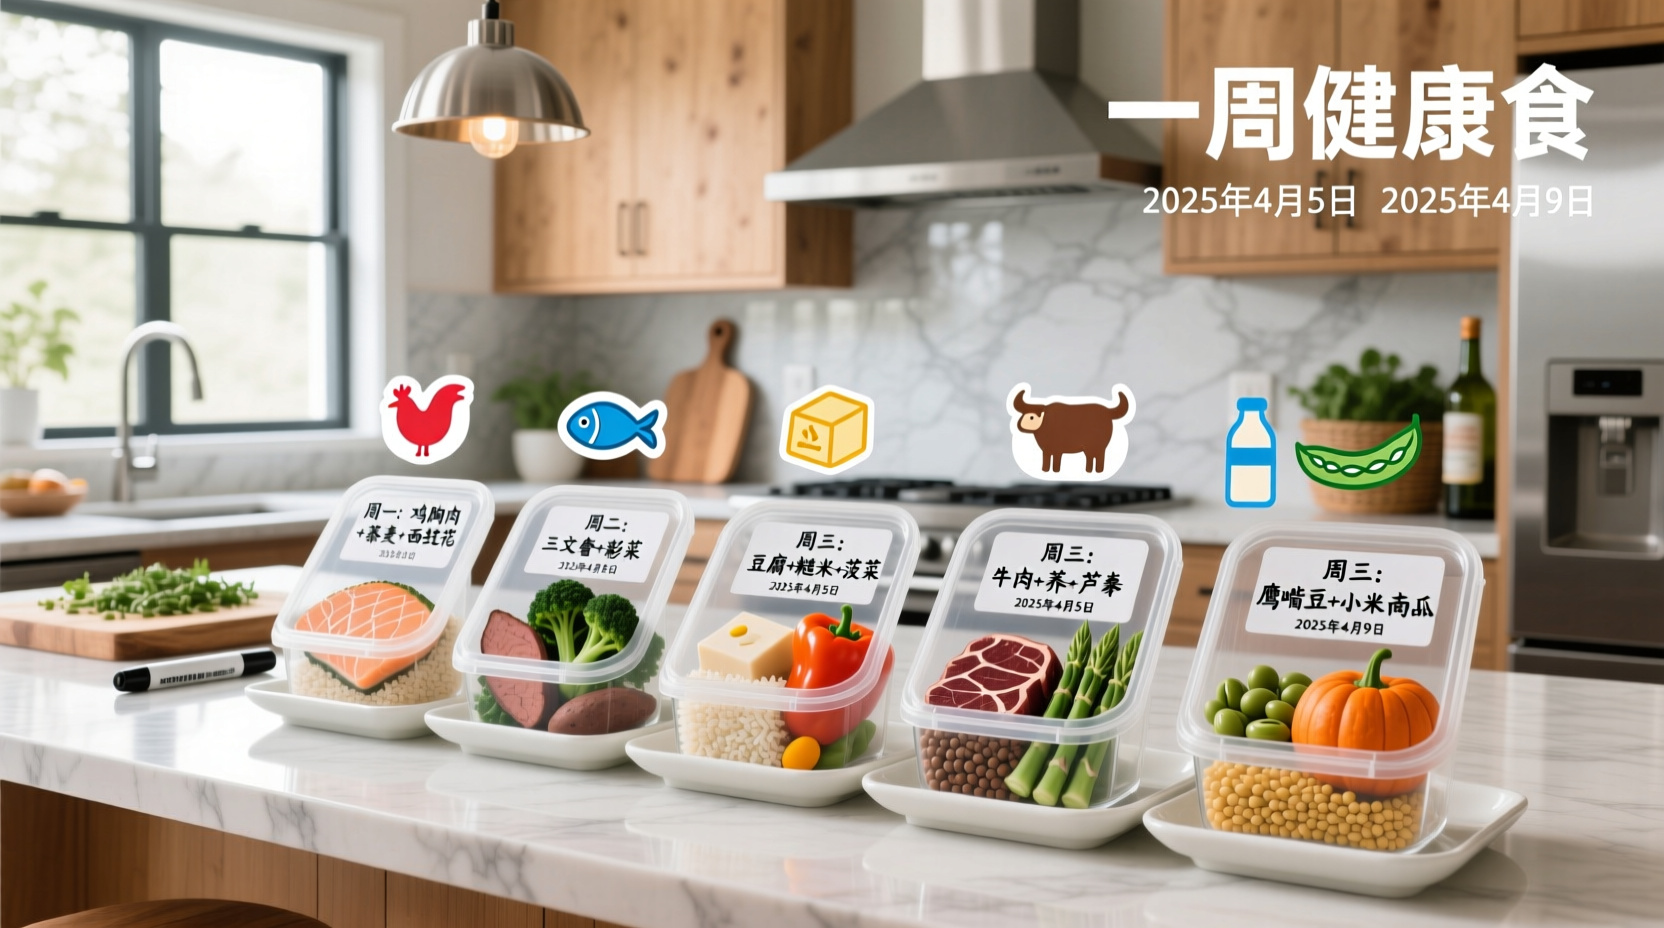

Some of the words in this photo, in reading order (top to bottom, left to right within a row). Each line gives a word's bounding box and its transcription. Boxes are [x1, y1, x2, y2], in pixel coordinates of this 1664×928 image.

[796, 531, 843, 551] 周三：
[1041, 543, 1093, 563] 周三：
[1323, 560, 1382, 583] 周三：
[1015, 598, 1093, 613] 2025年4月5日
[1295, 619, 1383, 635] 2025年4月9日
